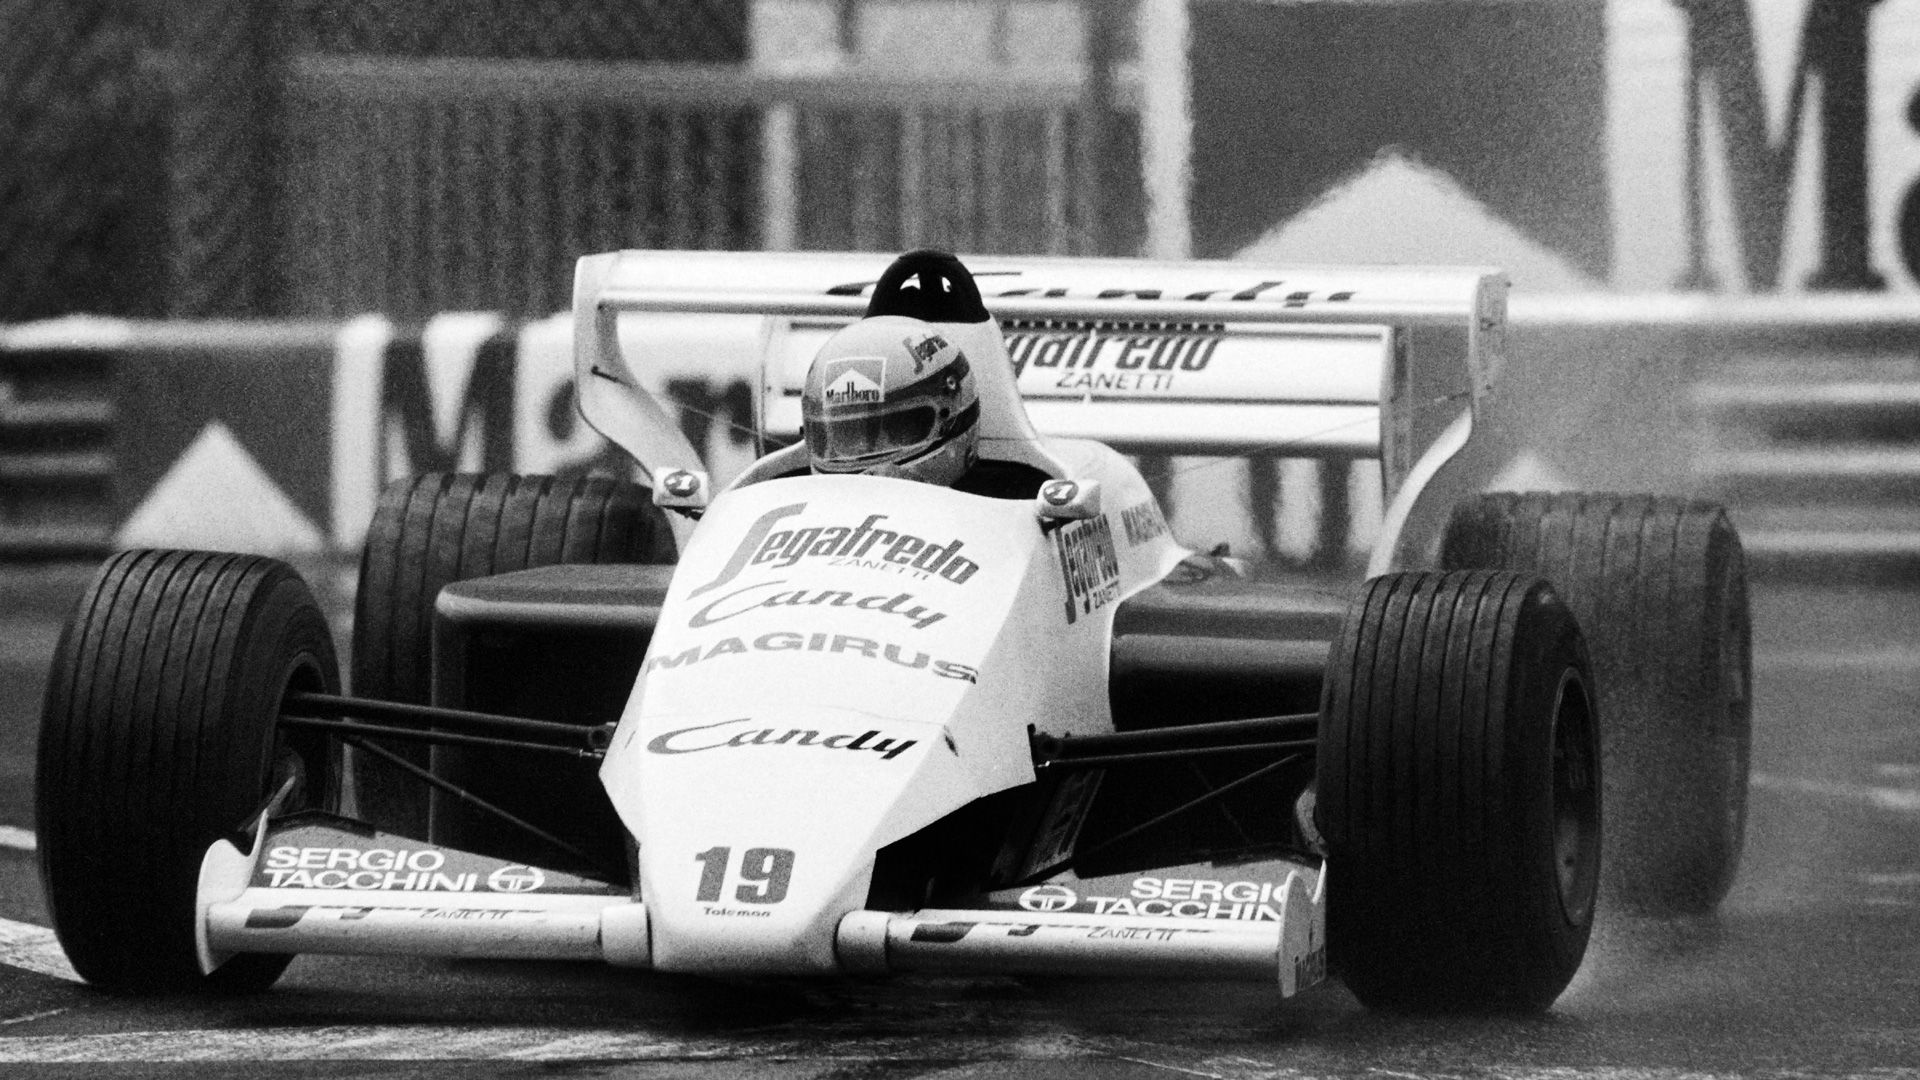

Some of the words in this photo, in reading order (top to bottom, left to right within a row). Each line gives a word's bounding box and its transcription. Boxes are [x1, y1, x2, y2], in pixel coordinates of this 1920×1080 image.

[1667, 0, 1920, 292] M
[826, 381, 880, 403] Marlboro
[1056, 372, 1174, 391] ZANETTI
[686, 502, 980, 601] Segafredo
[688, 580, 948, 630] Candy
[646, 632, 979, 684] MAGIRUS
[647, 718, 918, 760] Candy
[262, 868, 479, 892] TACCHINI
[266, 846, 445, 872] SERGIO
[695, 846, 796, 904] 19
